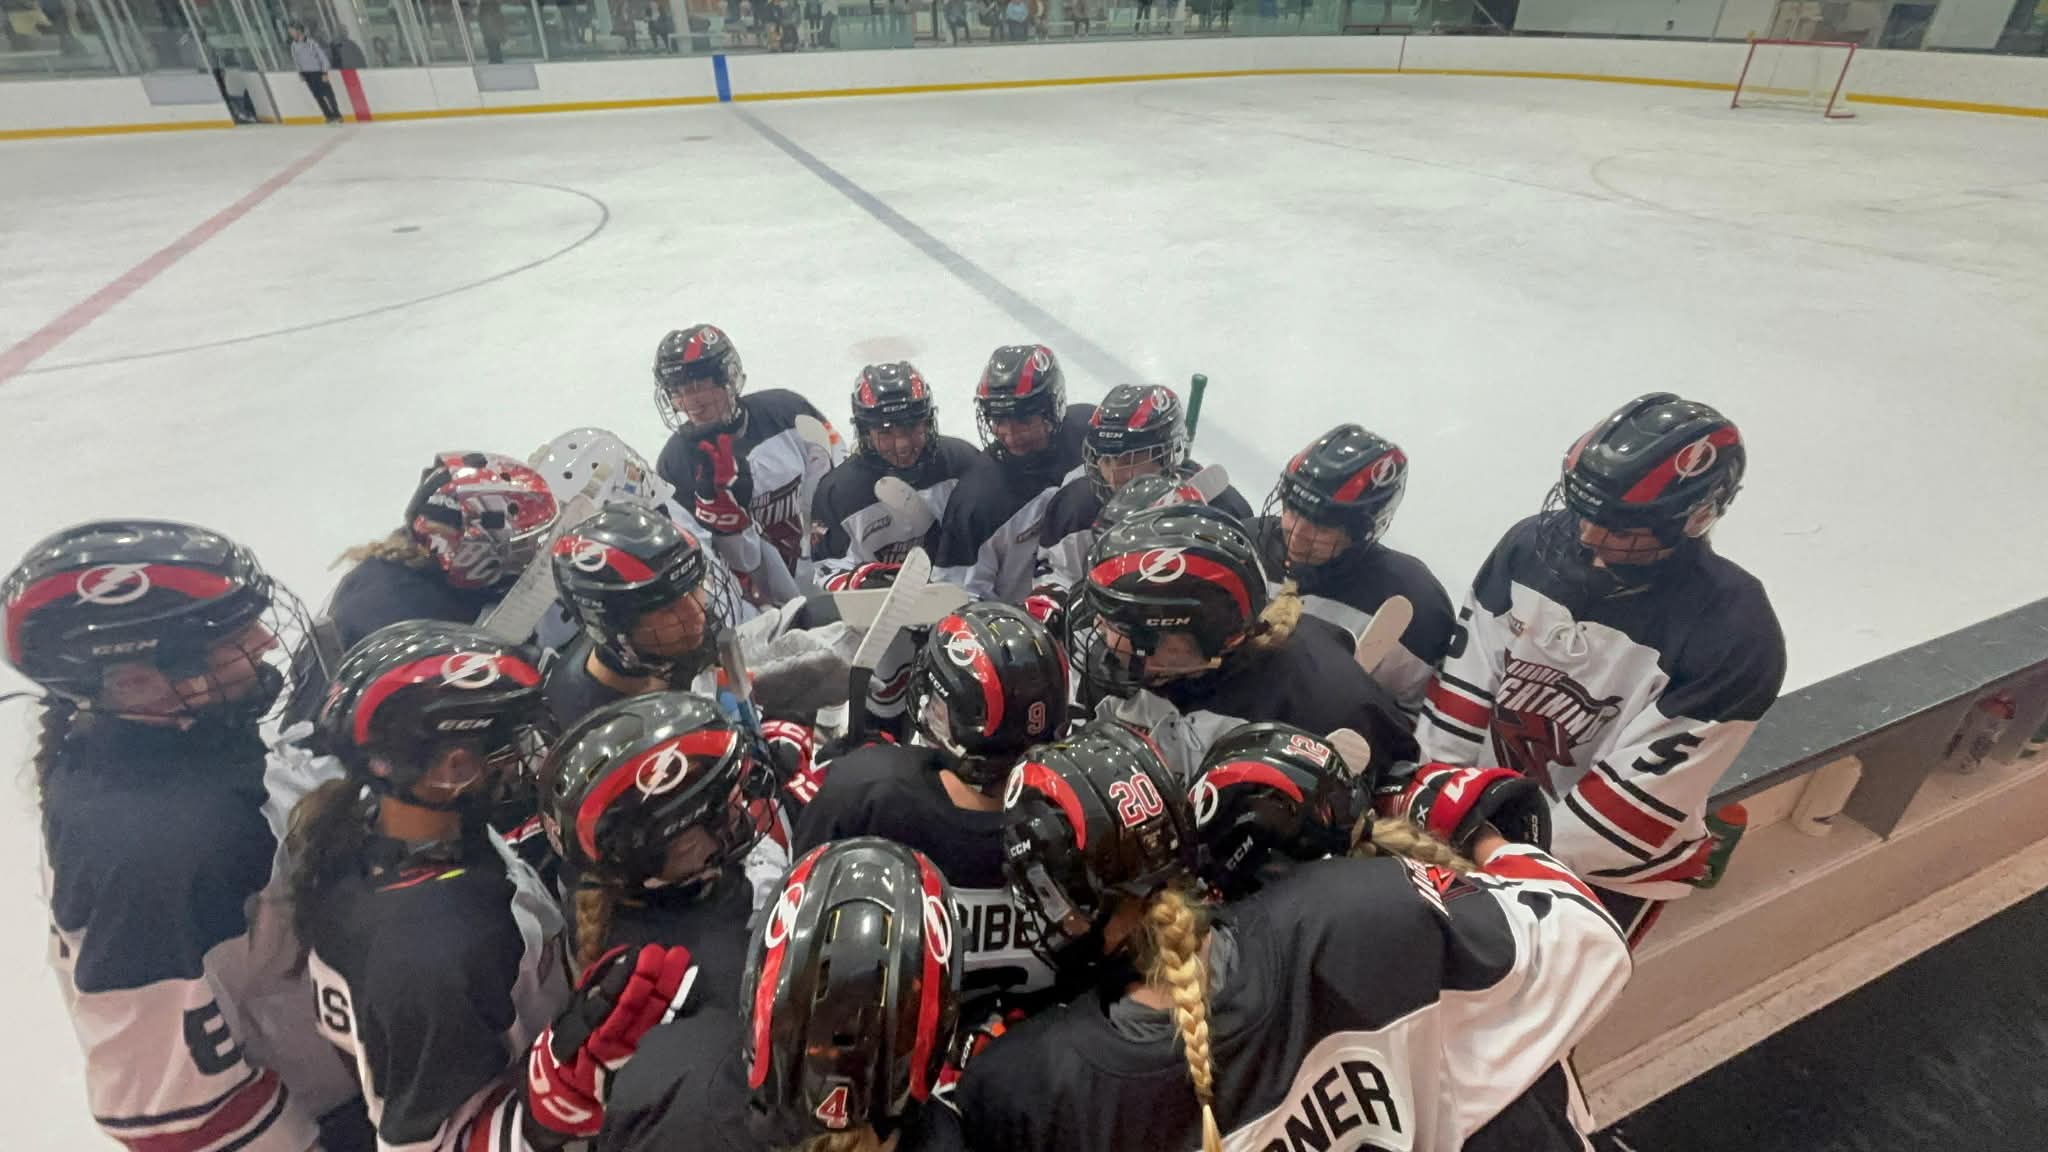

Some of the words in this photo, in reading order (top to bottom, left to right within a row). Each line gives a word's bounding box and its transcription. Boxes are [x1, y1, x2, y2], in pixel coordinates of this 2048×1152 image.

[1098, 431, 1124, 440] CCM
[1145, 617, 1191, 627] CCM
[1027, 701, 1047, 735] 9
[1286, 734, 1330, 769] 12
[1108, 772, 1165, 828] 20
[1009, 839, 1032, 858] CCM
[1225, 834, 1254, 872] CCM
[816, 1086, 849, 1130] 4
